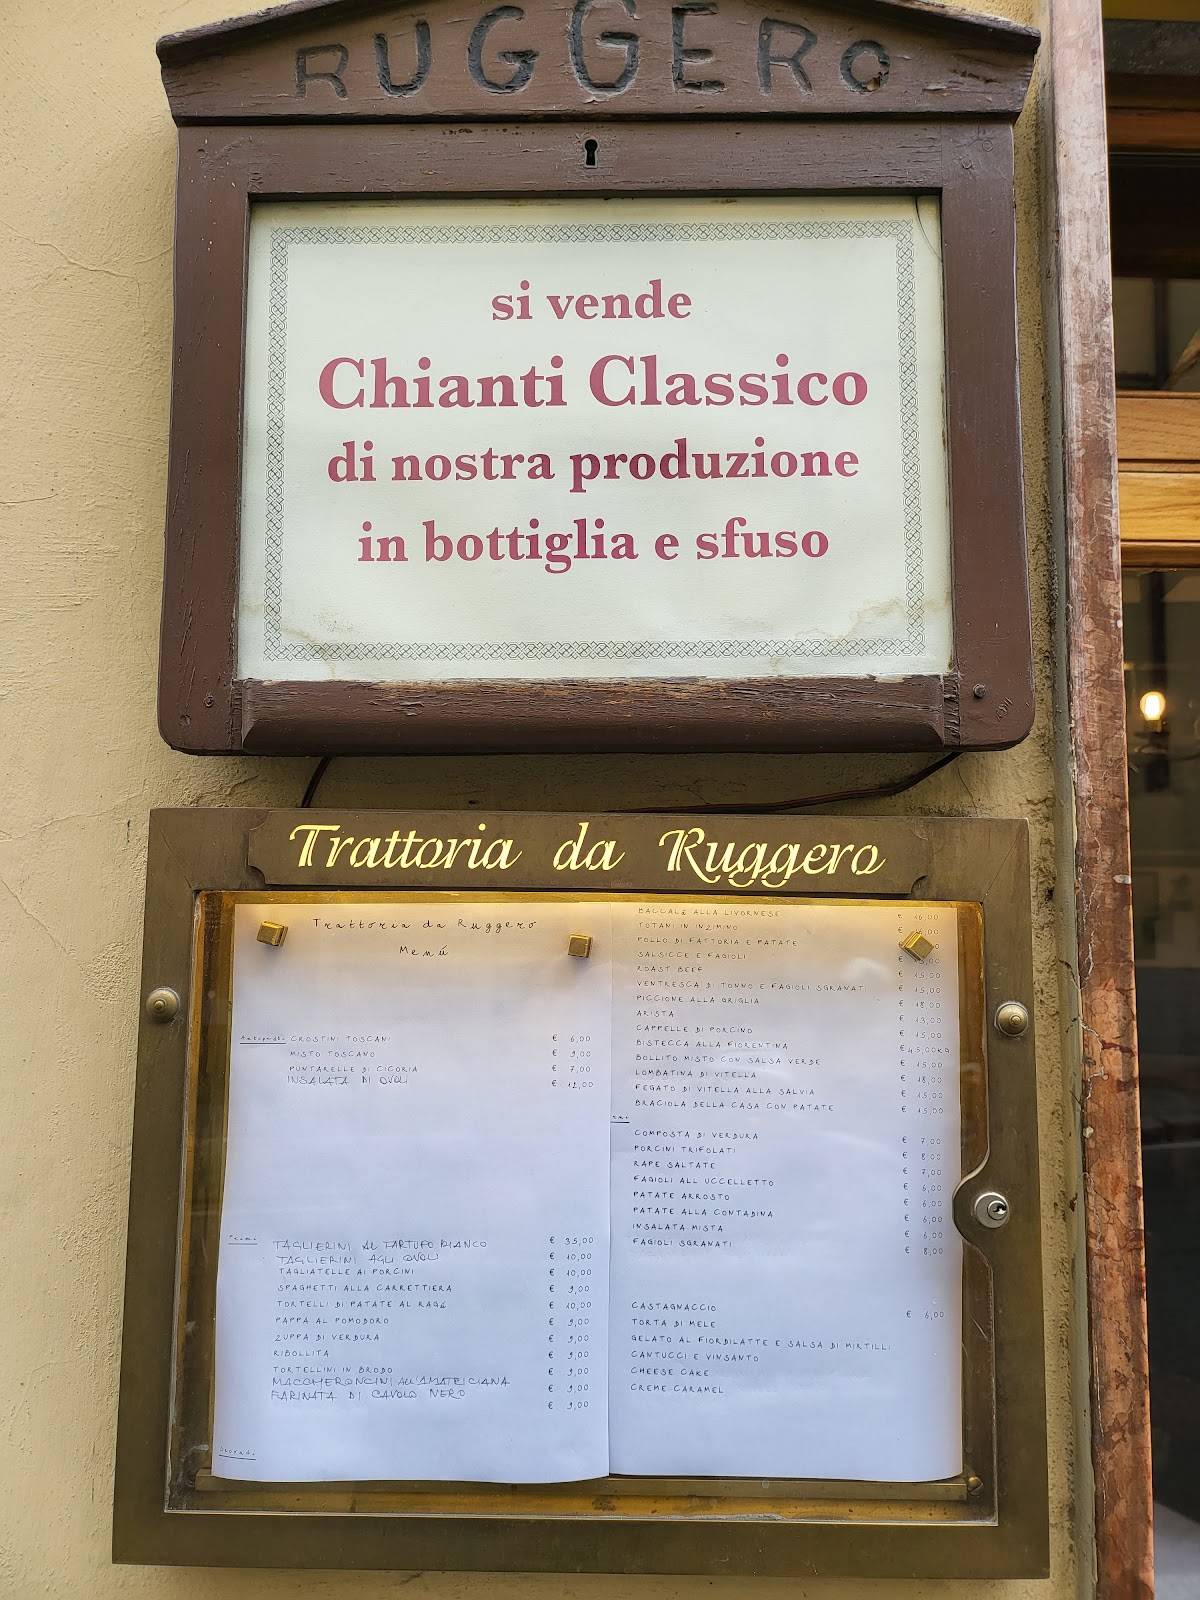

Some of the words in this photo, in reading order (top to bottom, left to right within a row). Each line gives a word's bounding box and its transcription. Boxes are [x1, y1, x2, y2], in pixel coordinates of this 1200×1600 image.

[295, 0, 892, 98] RUGGERO
[491, 279, 533, 321] si
[546, 278, 692, 320] vende
[318, 355, 568, 410] Chianti
[589, 353, 868, 407] Classico
[327, 440, 377, 483] di
[391, 447, 556, 481] nostra
[569, 436, 859, 494] produzione
[357, 520, 409, 562] in
[422, 517, 640, 574] bottiglia
[654, 533, 680, 561] e
[695, 516, 829, 560] sfuso
[288, 822, 522, 872] Trattoria
[551, 822, 623, 873] da
[658, 826, 886, 886] Ruggero
[312, 918, 411, 930] Trattoria
[422, 919, 446, 929] da
[457, 918, 537, 934] Ruggero
[639, 921, 675, 929] TOTANI
[637, 936, 669, 944] POLLO
[689, 937, 739, 945] FATTORIA
[757, 939, 798, 947] PATATE
[637, 951, 689, 959] SALSICCE
[707, 952, 746, 960] FAGIOLI
[637, 965, 670, 973] ROAST
[636, 979, 700, 989] VENTRESCA
[720, 982, 753, 990] TONNO
[771, 983, 811, 991] FAGIOLI
[636, 994, 684, 1003] PICCIONE
[689, 996, 715, 1004] ALLA
[721, 997, 760, 1005] GRIGLIA
[636, 1009, 674, 1018] ARISTA
[636, 1024, 688, 1033] CAPPELLE
[709, 1026, 753, 1034] PORCINO
[636, 1039, 689, 1048] BISTECCA
[695, 1041, 721, 1049] ALLA
[727, 1040, 788, 1051] FIORENTINA
[289, 1050, 321, 1058] MISTO
[327, 1050, 375, 1058] TOSCANO
[635, 1053, 678, 1062] BOLLITO
[683, 1055, 714, 1063] MISTO
[720, 1055, 741, 1063] CON
[747, 1057, 782, 1065] SALSA
[787, 1058, 821, 1066] VERDE
[635, 1069, 693, 1077] LOMBATINA
[714, 1071, 756, 1079] VITELLA
[635, 1083, 676, 1092] FEGATO
[680, 1085, 691, 1094] DI
[696, 1085, 739, 1094] VITELLA
[745, 1087, 772, 1095] ALLA
[778, 1088, 815, 1096] SALVIA
[635, 1098, 686, 1108] BRACIOLA
[692, 1101, 725, 1109] DELLA
[730, 1101, 760, 1110] CASA
[766, 1102, 787, 1110] CON
[792, 1103, 835, 1111] PATATE
[634, 1129, 690, 1139] COMPOSTA
[711, 1131, 758, 1140] VERDURA
[634, 1144, 675, 1153] PORCINI
[680, 1146, 736, 1154] TRIFOLATI
[633, 1160, 660, 1168] RAPE
[666, 1161, 715, 1170] SALTATE
[633, 1175, 673, 1184] FAGIOLI
[704, 1177, 774, 1187] UCCELLETTO
[633, 1191, 675, 1199] PATATE
[681, 1192, 730, 1201] ARROSTO
[633, 1207, 675, 1215] PATATE
[681, 1208, 707, 1216] ALLA
[713, 1208, 773, 1219] CONTADINA
[632, 1223, 685, 1232] INSALATA
[691, 1224, 723, 1233] MISTA
[632, 1237, 673, 1246] FAGIOLI
[279, 1267, 351, 1276] TAGLIATELLE
[356, 1268, 366, 1276] AI
[372, 1267, 414, 1276] PORCINI
[277, 1284, 337, 1292] SPAGHETTI
[343, 1284, 369, 1293] ALLA
[376, 1284, 452, 1293] CARRETTIERA
[276, 1300, 328, 1308] TORTELLI
[350, 1300, 393, 1308] PATATE
[399, 1300, 411, 1309] AL
[631, 1301, 717, 1312] CASTAGNACCIO
[275, 1316, 309, 1325] PAPPA
[315, 1317, 328, 1325] AL
[335, 1317, 389, 1326] POMODORO
[631, 1318, 667, 1327] TORTA
[689, 1320, 716, 1329] MELE
[331, 1333, 380, 1342] VERDURA
[631, 1334, 672, 1343] GELATO
[678, 1335, 692, 1344] AL
[698, 1336, 768, 1347] FIORDILATTE
[775, 1339, 781, 1347] E
[787, 1339, 823, 1350] SALSA
[273, 1349, 329, 1358] RIBOLLITA
[630, 1350, 687, 1360] CANTUCCI
[693, 1353, 699, 1361] E
[705, 1353, 759, 1362] VINSANTO
[272, 1366, 336, 1374] TORTELLINI
[358, 1366, 393, 1375] BRODO
[630, 1366, 673, 1376] CHEESE
[680, 1368, 709, 1377] CAKE
[630, 1383, 668, 1393] CREME
[673, 1384, 724, 1394] CARAMEL
